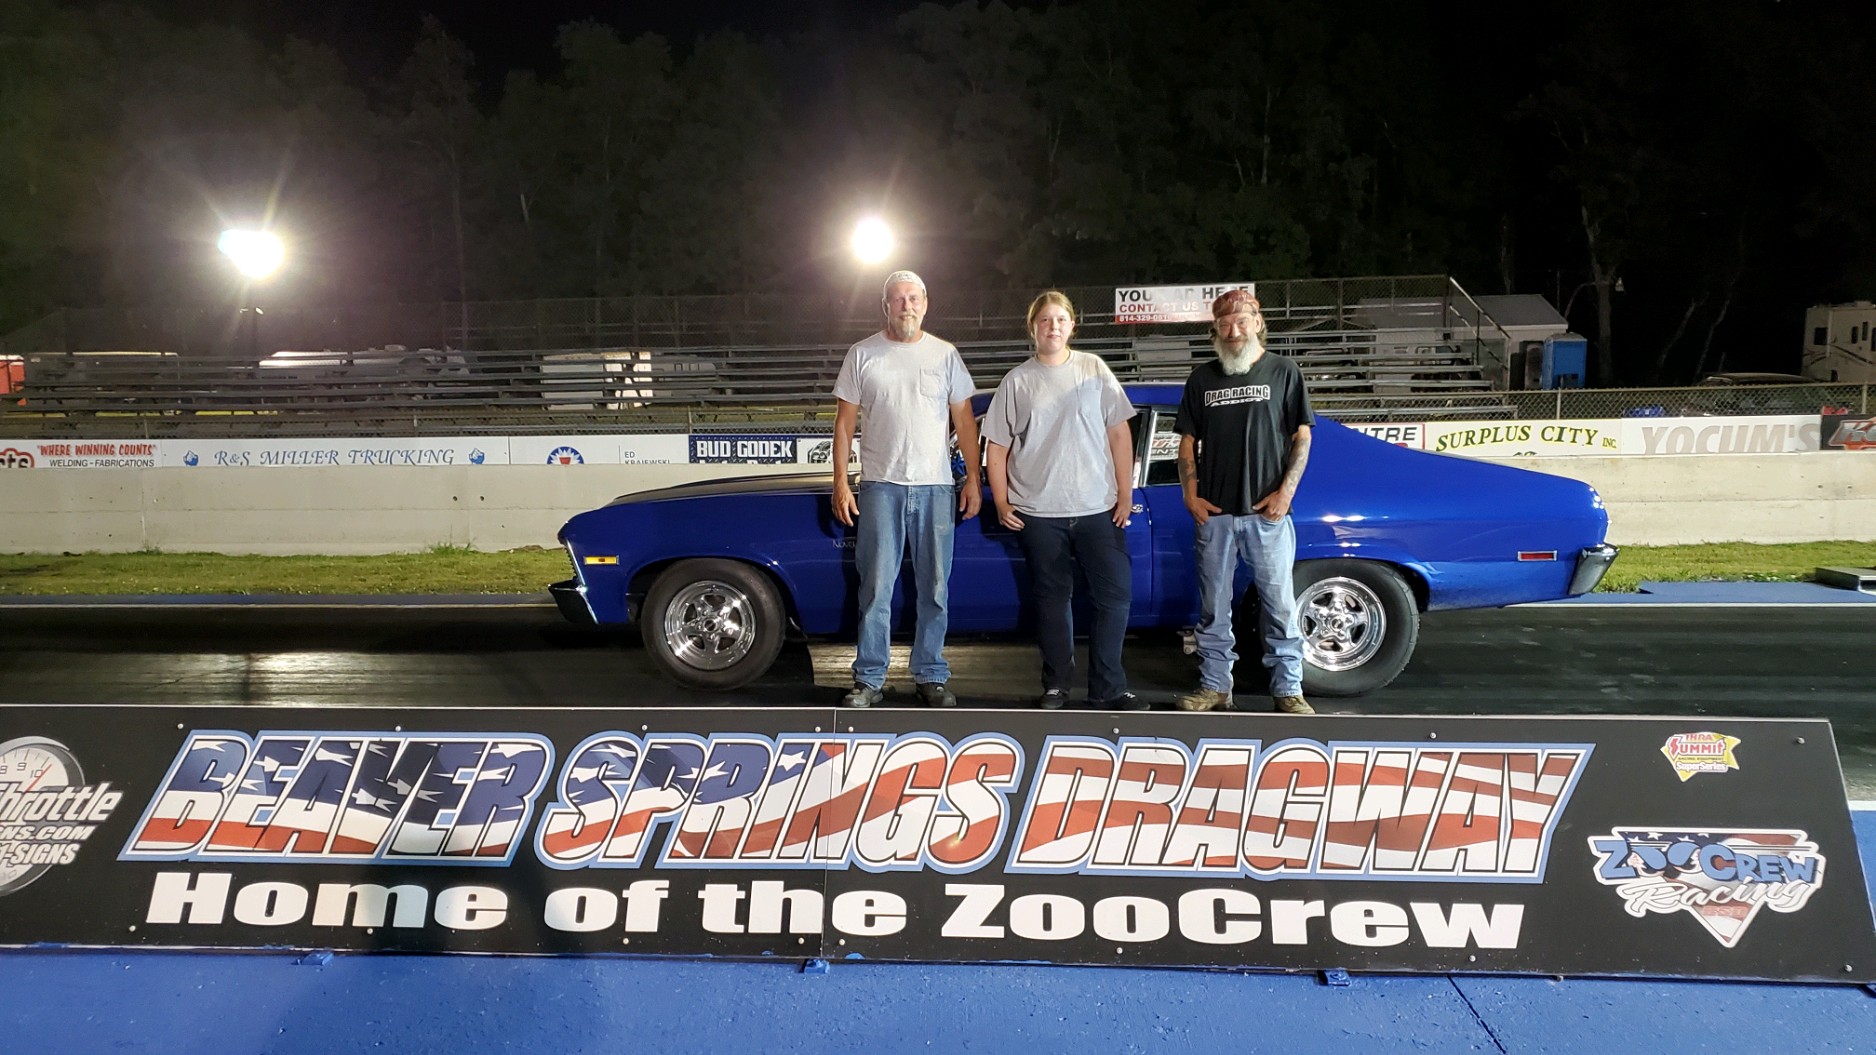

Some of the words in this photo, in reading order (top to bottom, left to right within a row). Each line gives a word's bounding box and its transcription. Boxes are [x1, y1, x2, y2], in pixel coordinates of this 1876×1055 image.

[1118, 289, 1163, 302] YOU
[1202, 286, 1249, 299] HE
[1119, 302, 1178, 313] CONTACT
[1182, 301, 1200, 312] US
[1205, 389, 1230, 406] DRAG
[1231, 385, 1271, 400] RACING
[1210, 397, 1264, 407] ADDICT
[1436, 425, 1532, 452] SURPLUS
[1540, 425, 1599, 447] CITY
[1641, 423, 1820, 454] YOCUM'S
[75, 443, 115, 456] WINNING
[213, 450, 251, 466] R&S
[260, 450, 340, 466] MILLER
[347, 449, 455, 466] TRUCKING
[624, 451, 636, 459] ED
[696, 440, 731, 458] BUD
[736, 440, 793, 458] GODEK
[50, 459, 88, 468] WELDING
[95, 459, 155, 468] FABRICATIONS
[1669, 737, 1726, 759] SUMMIT
[118, 731, 553, 867] BEAVER
[535, 731, 1026, 872] SPRINGS
[1004, 736, 1597, 882] DRAGWAY
[1617, 876, 1812, 914] Racing
[145, 872, 509, 930] Home
[543, 879, 669, 932] of
[697, 880, 908, 935] the
[941, 883, 1525, 949] ZooCrew
